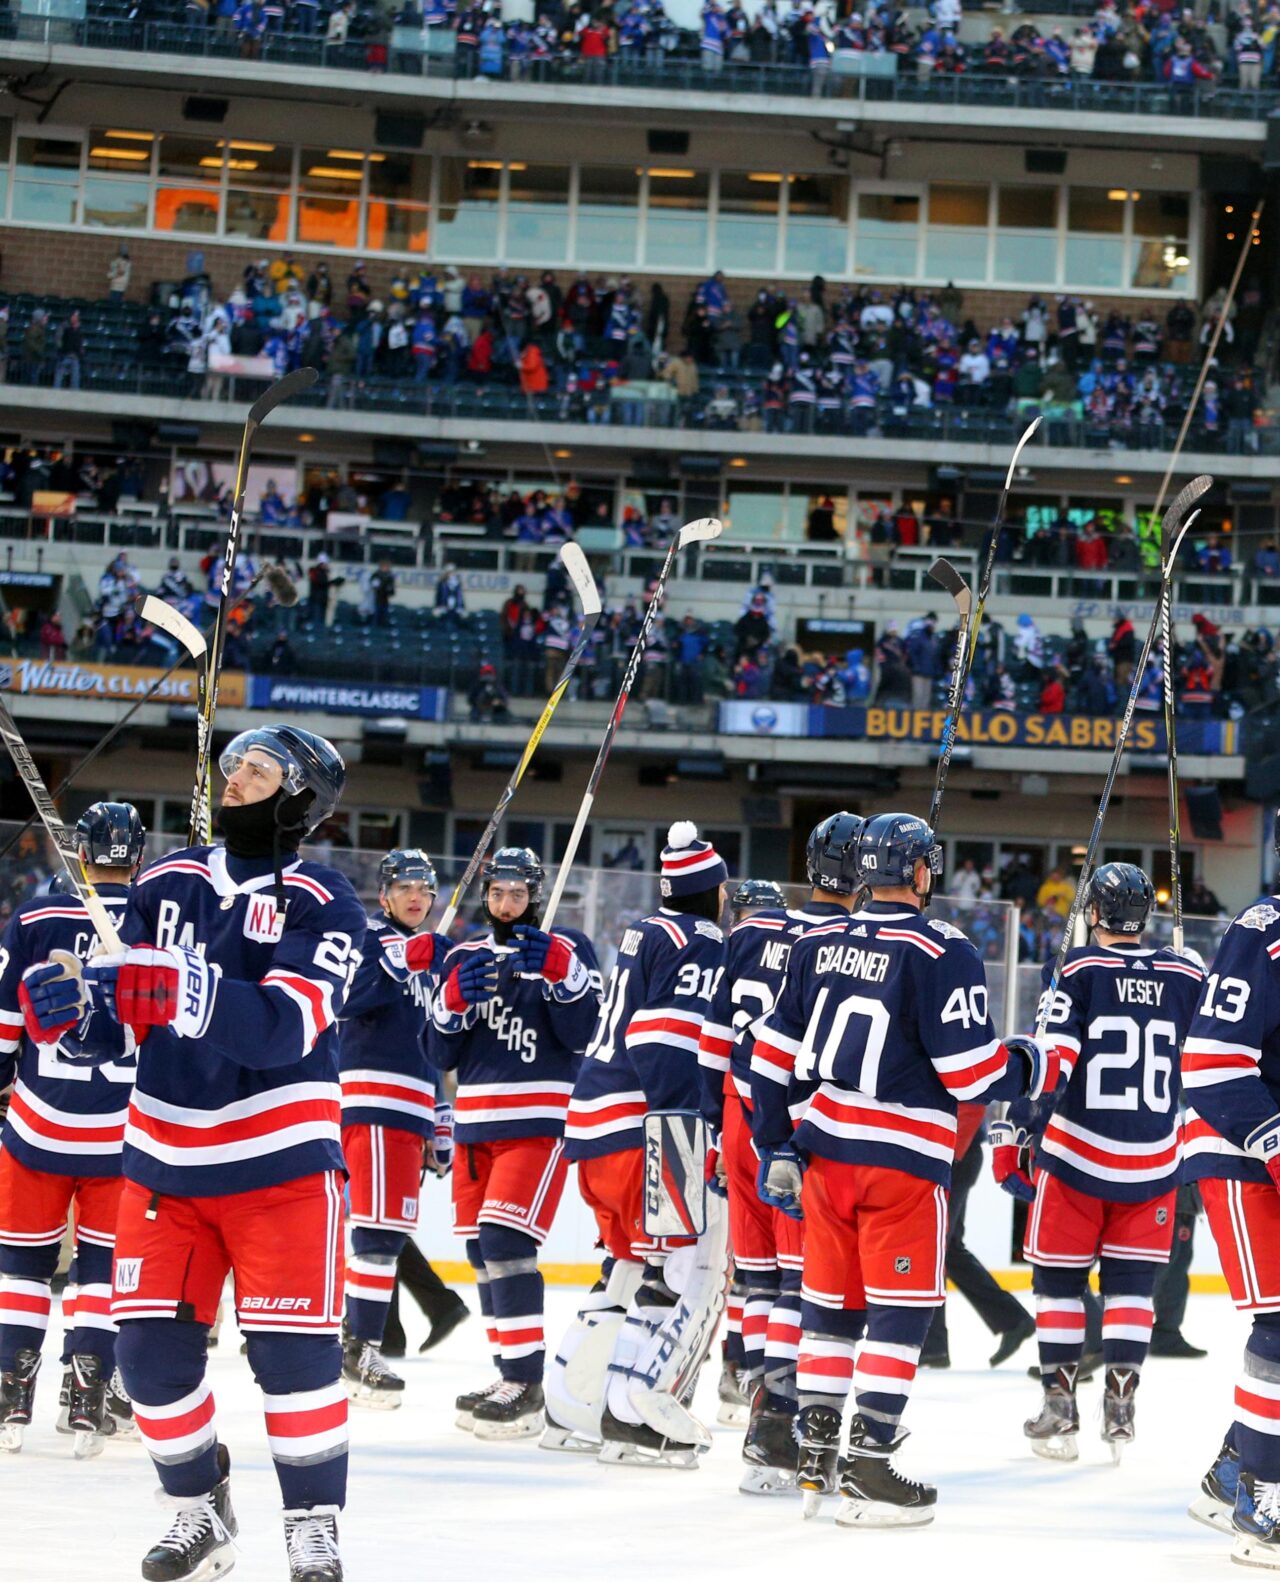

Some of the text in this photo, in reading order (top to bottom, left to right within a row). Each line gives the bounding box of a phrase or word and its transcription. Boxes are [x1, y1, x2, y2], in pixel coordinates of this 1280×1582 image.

[14, 658, 105, 694] Winter
[270, 685, 421, 711] #WINTERCLASSIC
[865, 708, 1016, 743] BUFFALO
[1024, 714, 1157, 749] SABRES
[942, 725, 958, 767] BAUER
[109, 844, 128, 858] 28
[861, 853, 878, 870] 40
[819, 874, 838, 889] 24
[1061, 911, 1078, 954] BAUER
[1122, 920, 1140, 932] 26
[180, 944, 203, 1018] AUER
[674, 963, 713, 1002] 31
[815, 945, 890, 984] GRABNER
[940, 984, 989, 1030] 40
[1116, 977, 1164, 1007] VESEY
[1200, 973, 1251, 1023] 13
[474, 995, 537, 1063] NGERS
[794, 986, 891, 1098] 40
[1085, 1015, 1177, 1114] 26
[647, 1135, 660, 1217] CCM
[483, 1199, 528, 1217] BAUER
[117, 1263, 137, 1289] N.Y.
[240, 1296, 312, 1311] BAUER
